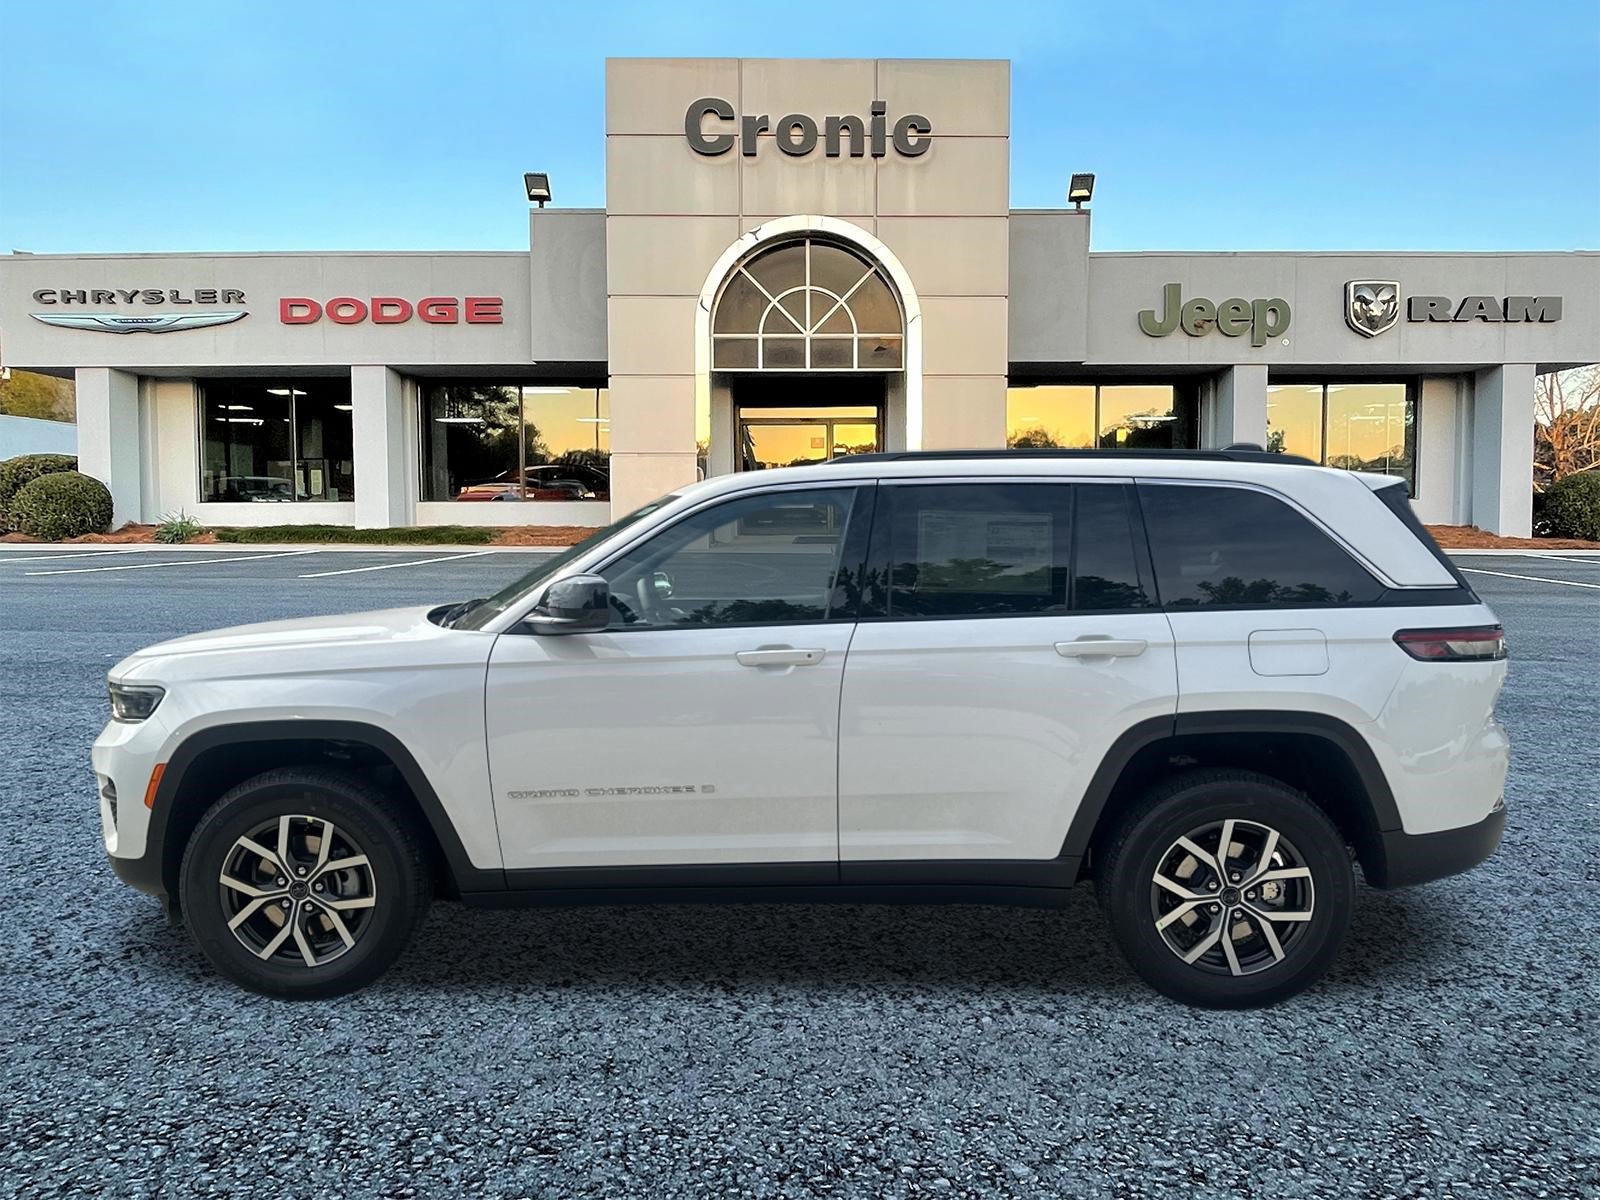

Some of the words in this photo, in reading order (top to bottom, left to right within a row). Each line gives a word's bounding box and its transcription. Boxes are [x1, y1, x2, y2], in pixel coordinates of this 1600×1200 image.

[685, 97, 933, 157] Cronic
[32, 289, 247, 304] CHRYSLER
[1407, 296, 1563, 323] RAM
[279, 297, 504, 325] DODGE
[1138, 283, 1291, 347] Jeep
